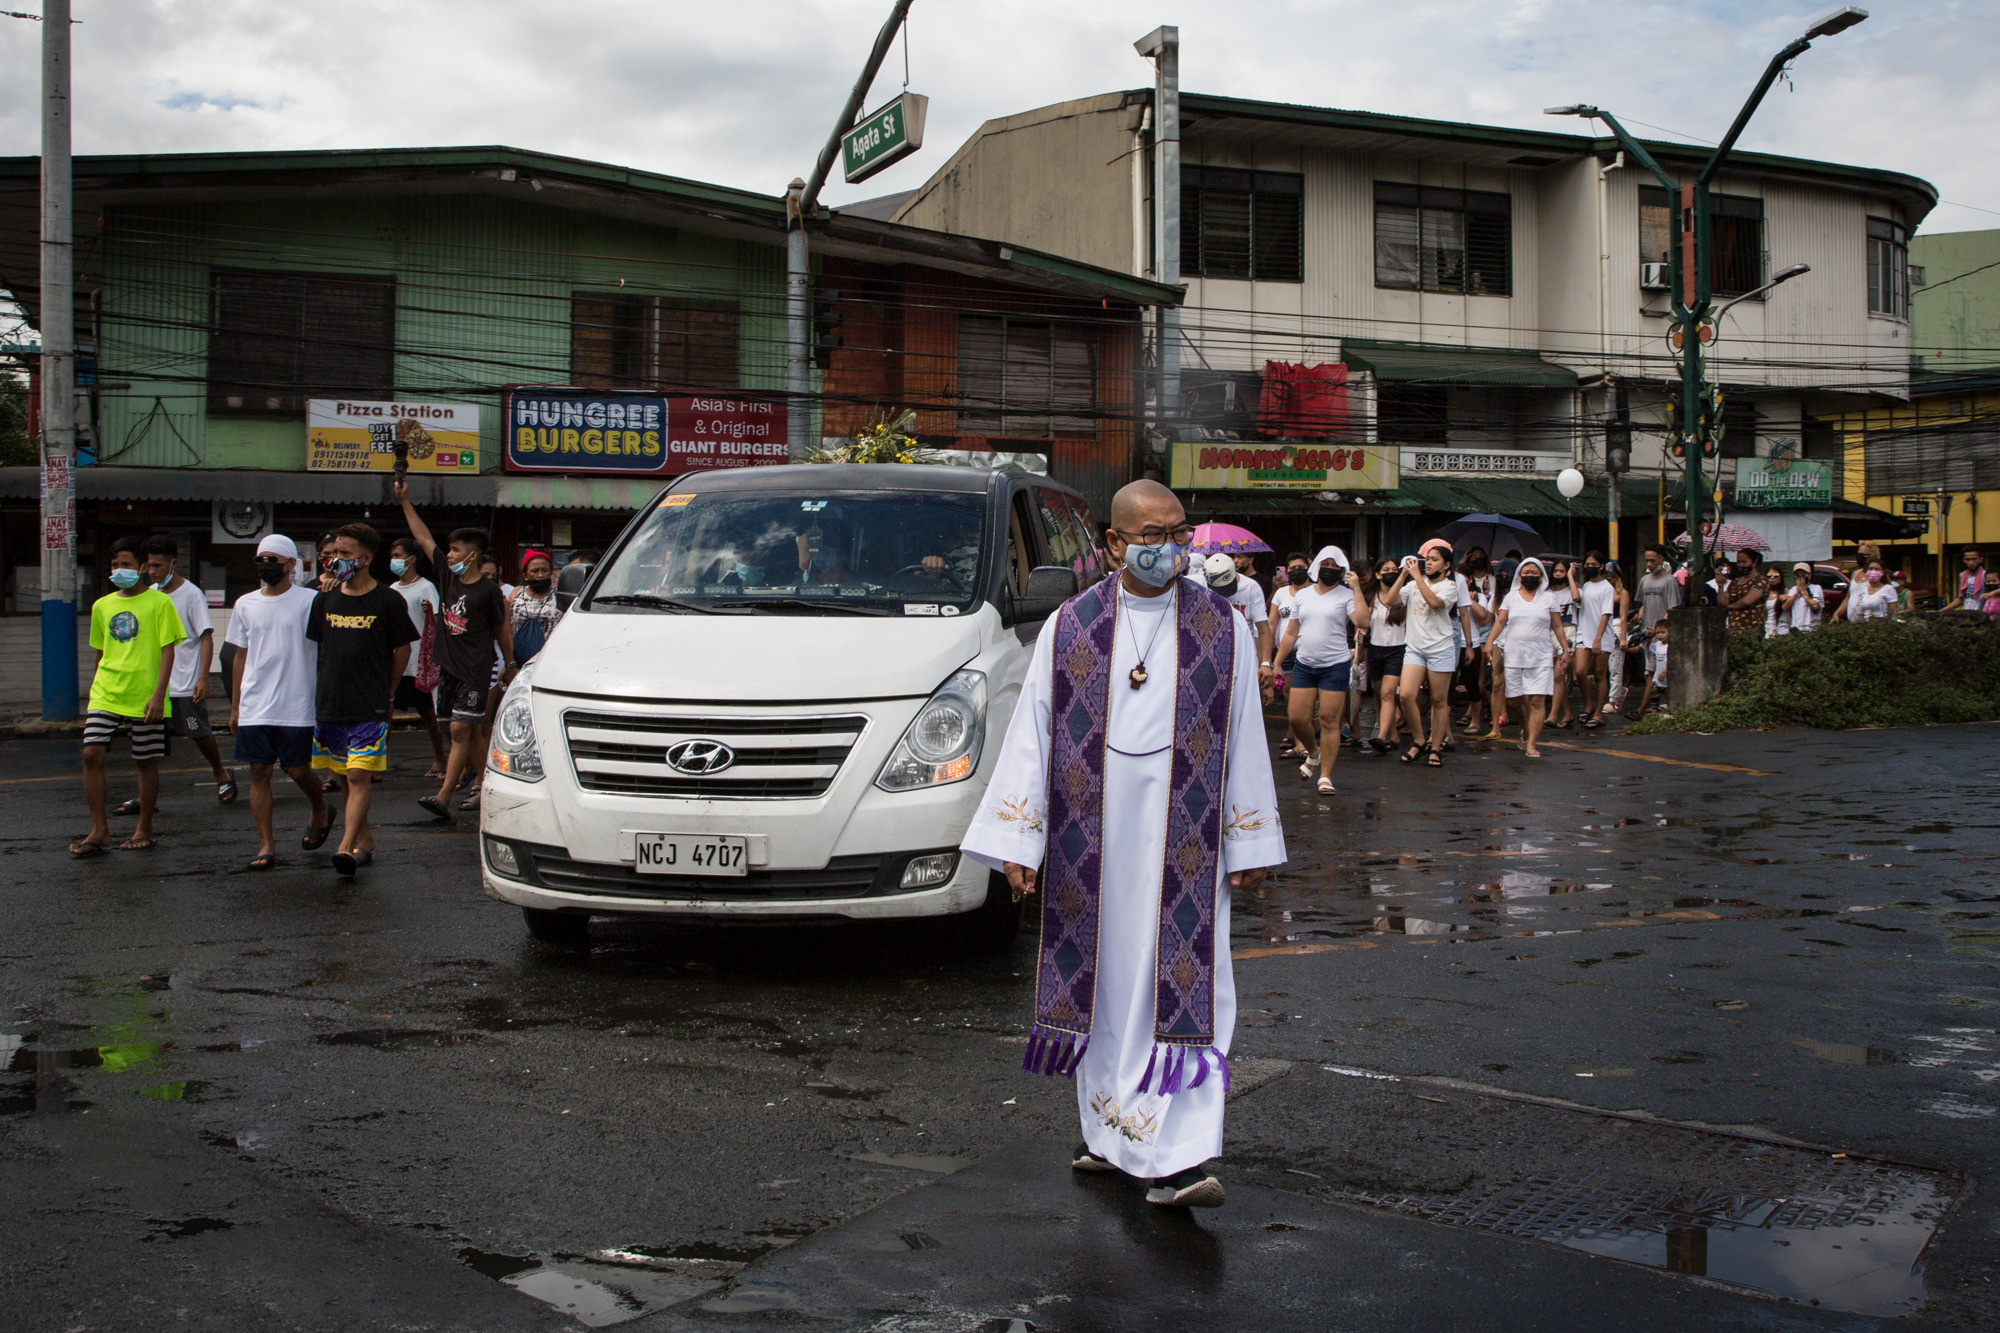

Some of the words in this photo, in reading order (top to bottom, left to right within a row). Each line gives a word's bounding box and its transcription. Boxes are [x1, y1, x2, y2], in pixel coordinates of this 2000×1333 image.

[852, 127, 880, 161] Agata
[883, 113, 896, 139] St
[336, 403, 383, 416] Pizza
[390, 405, 455, 418] Station
[690, 398, 736, 412] Asia's
[740, 400, 774, 414] First
[516, 400, 660, 429] HUNGREE
[369, 424, 390, 433] BUY
[390, 424, 397, 441] 1
[694, 419, 707, 434] &
[711, 420, 770, 438] Original
[372, 433, 390, 441] GET
[516, 428, 661, 456] BURGERS
[314, 450, 370, 459] 09171549178
[370, 442, 394, 454] FRE
[670, 440, 717, 453] GIANT
[311, 459, 371, 469] 02-758719-42
[686, 457, 714, 466] SINCE
[1750, 471, 1769, 488] DO
[1770, 476, 1788, 488] THE
[1789, 472, 1820, 488] DEW
[467, 691, 478, 707] 3
[639, 842, 677, 865] NCJ
[692, 844, 743, 867] 4707
